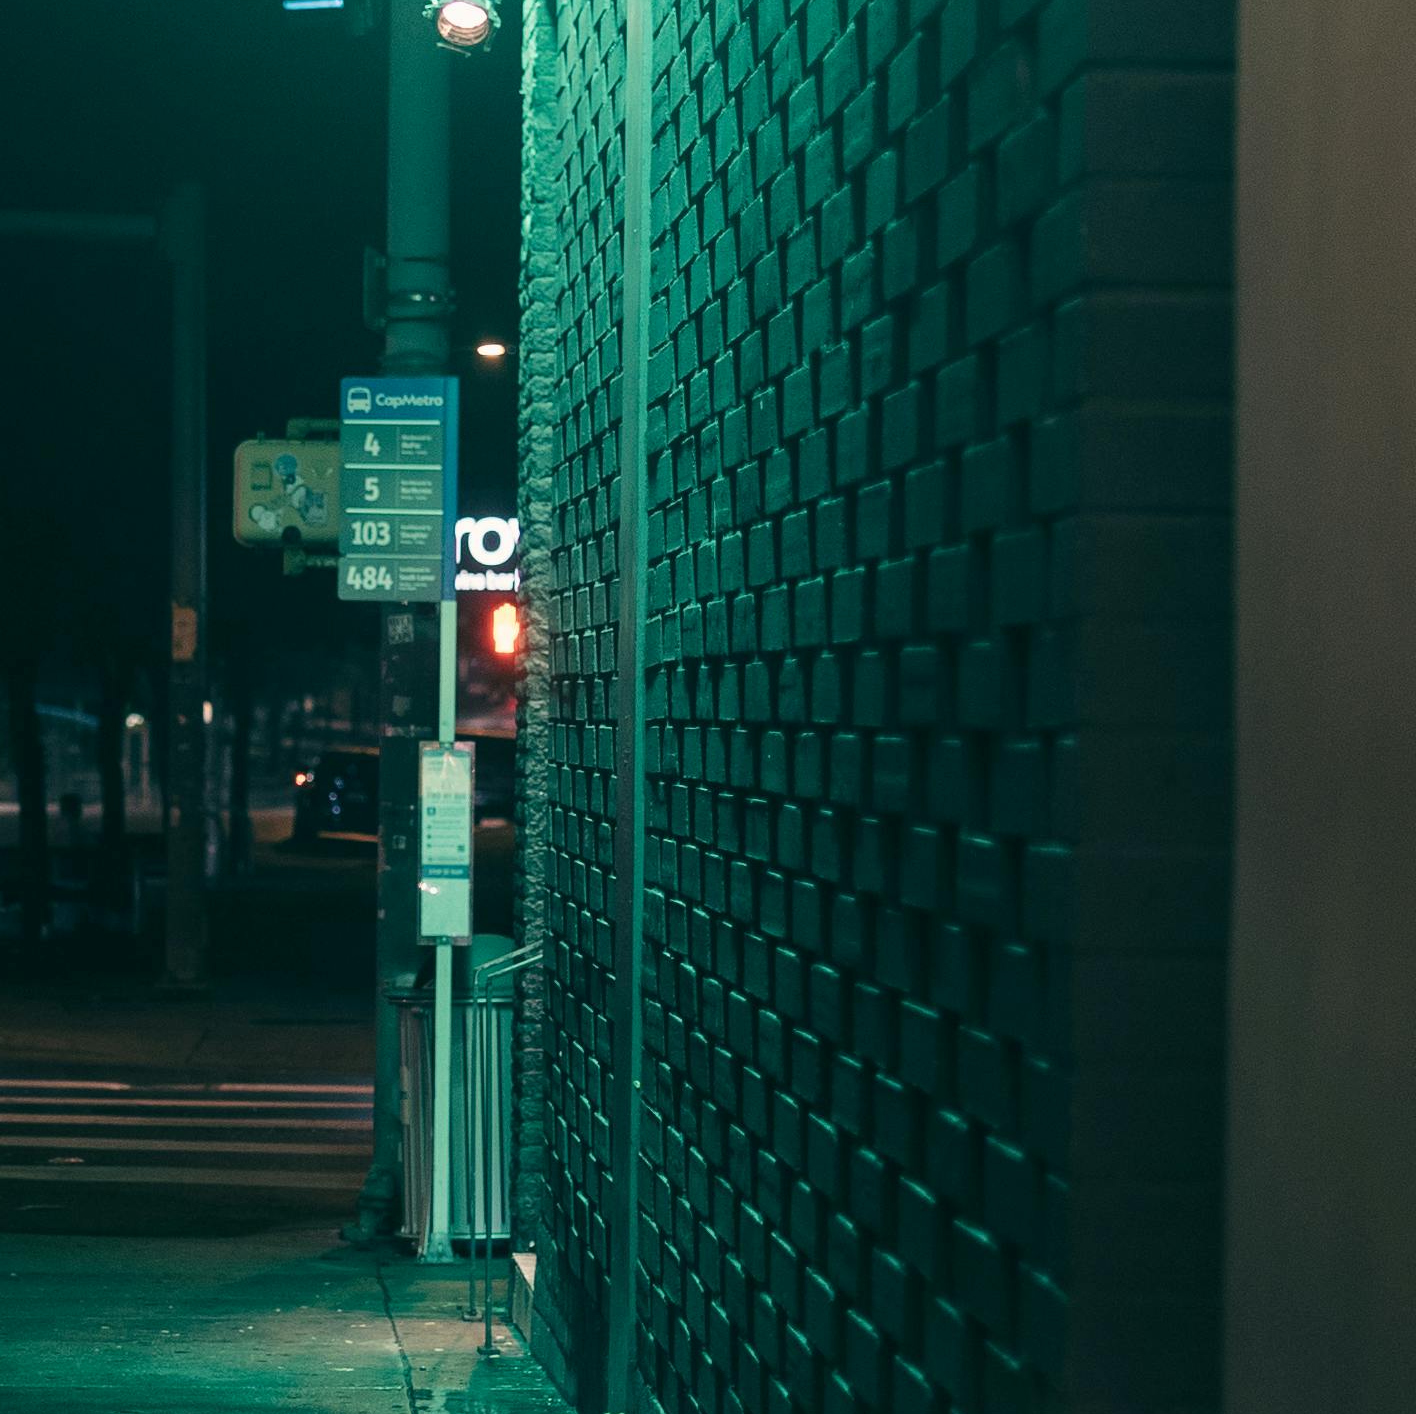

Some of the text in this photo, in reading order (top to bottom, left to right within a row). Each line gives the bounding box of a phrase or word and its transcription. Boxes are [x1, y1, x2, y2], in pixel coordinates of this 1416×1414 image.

[375, 393, 444, 408] CapMetro
[364, 432, 381, 457] 4
[364, 476, 380, 502] 5
[351, 520, 391, 546] 103
[346, 566, 393, 590] 484
